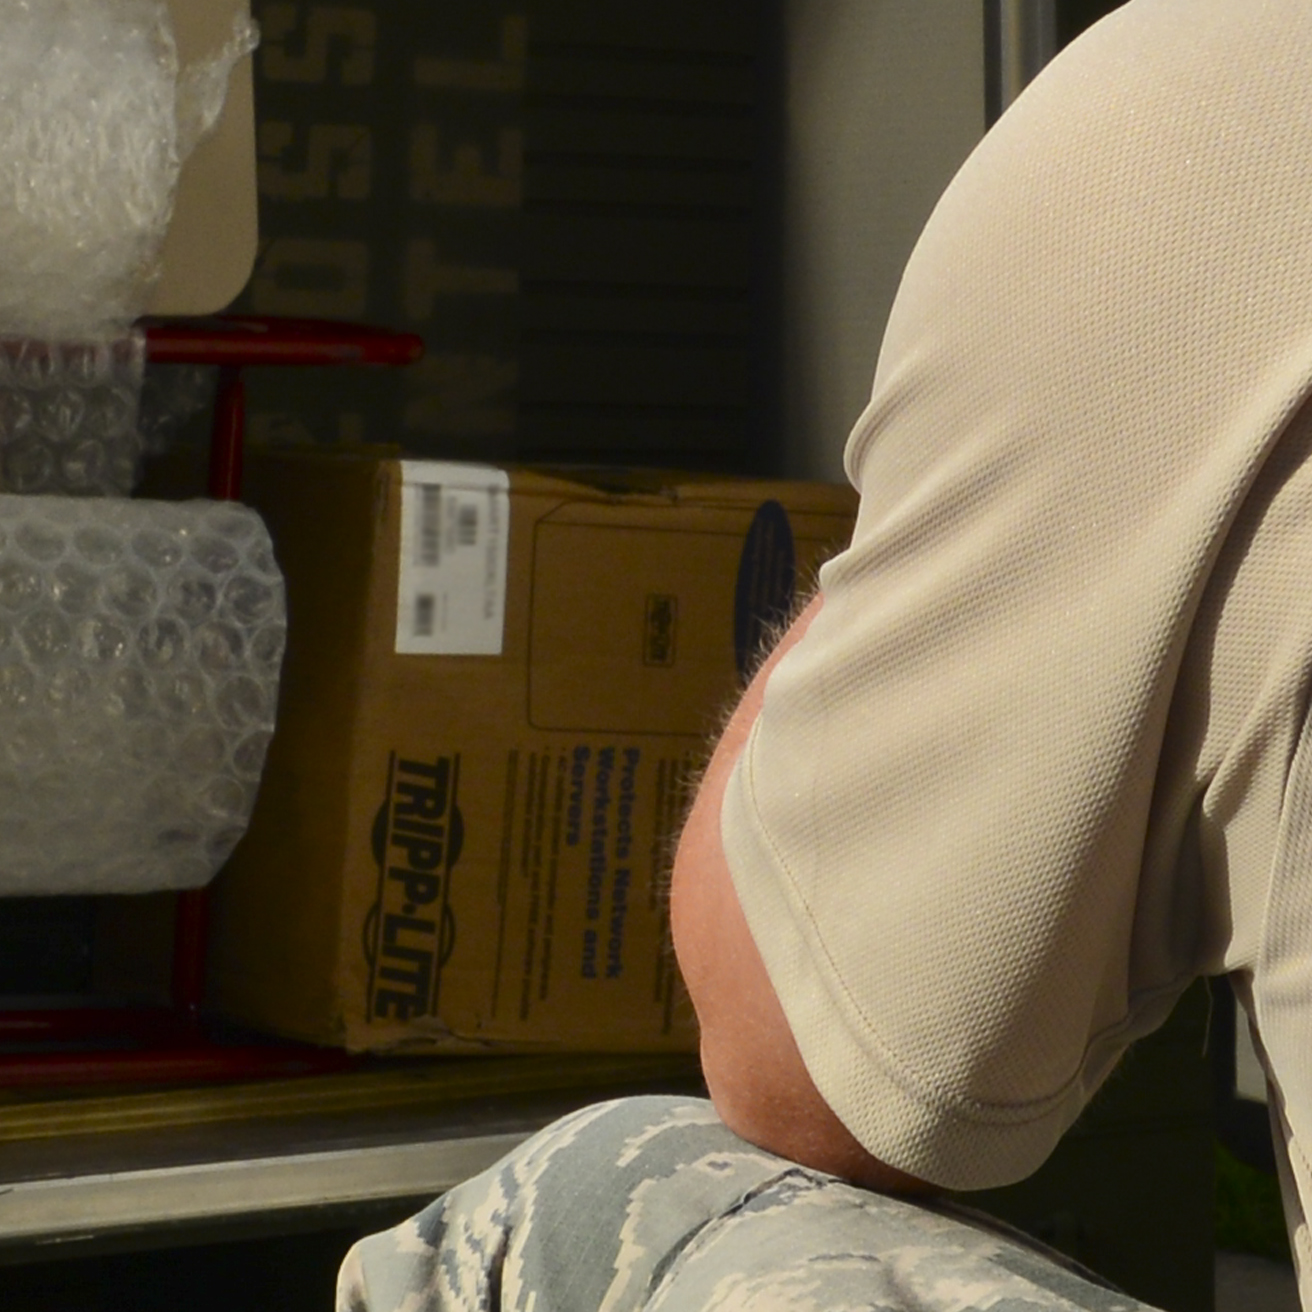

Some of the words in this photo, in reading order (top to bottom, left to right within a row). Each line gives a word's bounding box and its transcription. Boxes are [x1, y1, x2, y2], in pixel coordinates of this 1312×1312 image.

[252, 3, 380, 319] OSS
[402, 13, 530, 434] NTEL
[565, 744, 592, 848] Servers
[585, 746, 617, 921] Workstations
[615, 746, 641, 860] Protects
[580, 929, 600, 979] and
[605, 867, 633, 979] Network
